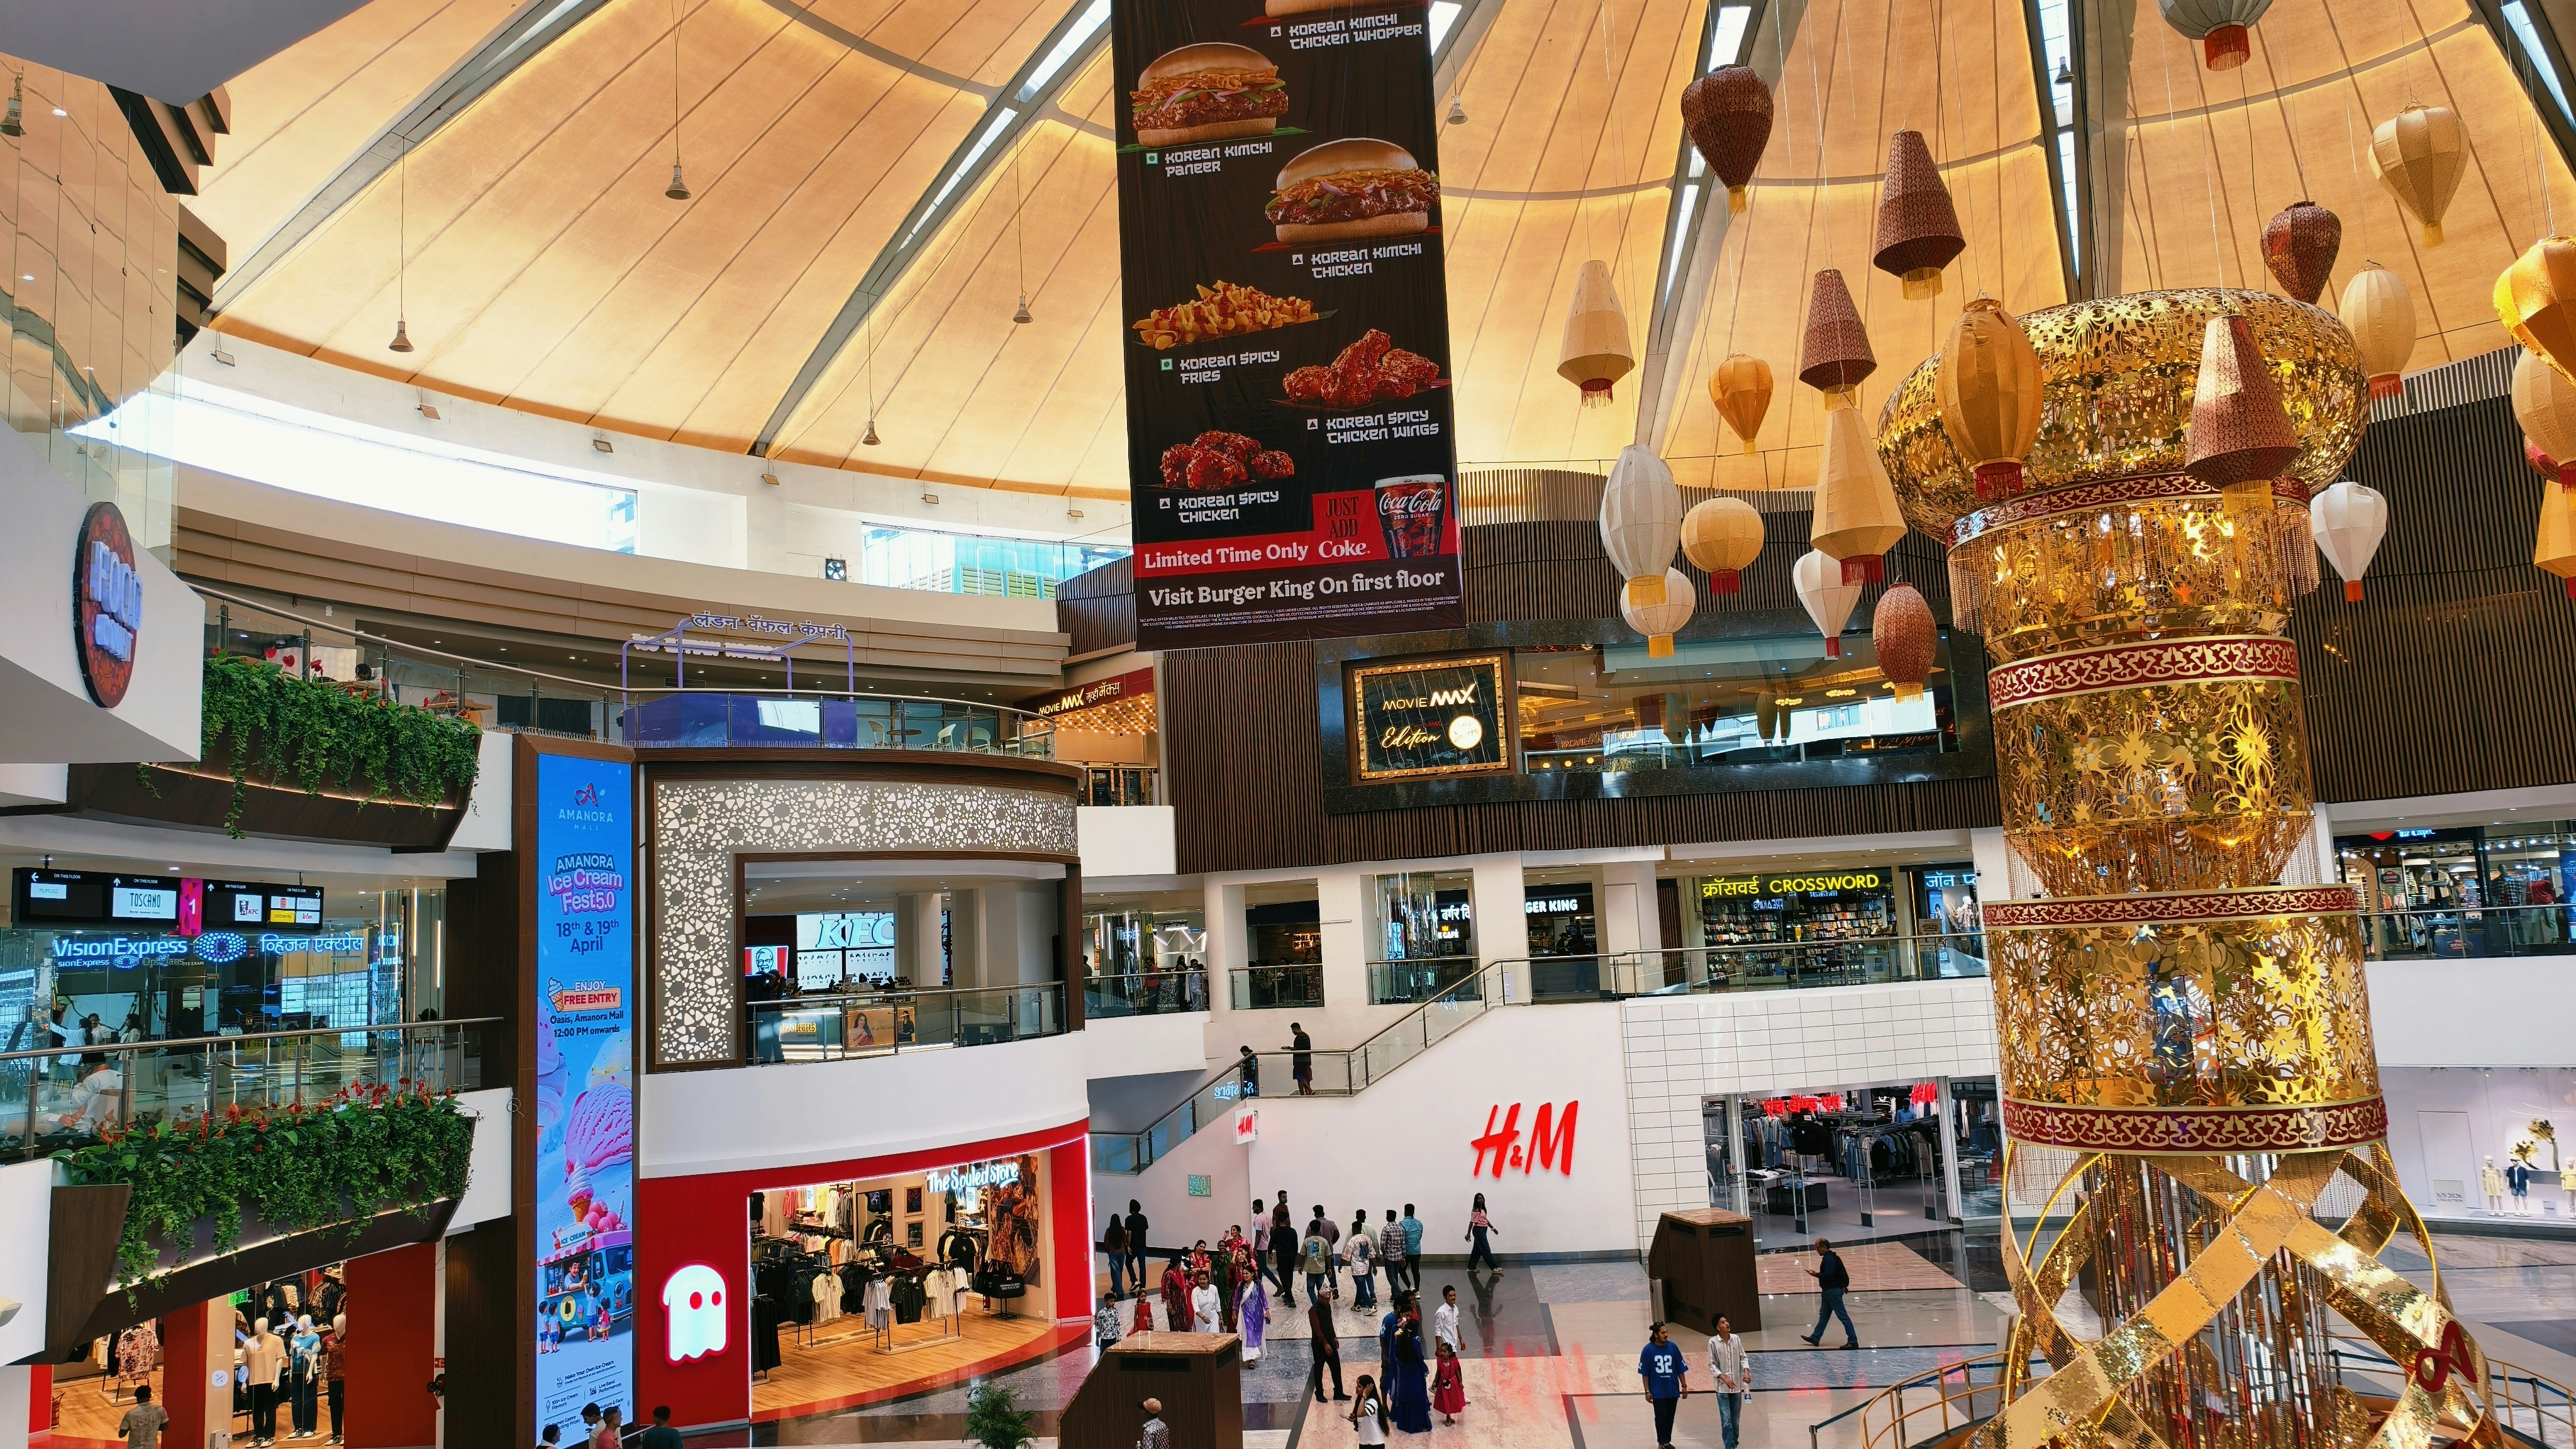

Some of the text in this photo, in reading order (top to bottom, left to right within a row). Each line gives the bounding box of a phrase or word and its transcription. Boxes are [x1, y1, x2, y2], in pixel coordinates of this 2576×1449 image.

[1350, 14, 1397, 31] KIMCHI
[1354, 24, 1422, 43] WHOPPER
[1224, 142, 1272, 157] KIMCHI
[1372, 243, 1421, 260] KIMCHI
[1240, 350, 1280, 365] SPICY
[1388, 409, 1430, 425] SPICY
[1240, 491, 1279, 504] SPICY
[1325, 497, 1358, 517] JUST
[1329, 518, 1358, 538] ADD
[1144, 542, 1309, 569] Limited Time Only
[90, 541, 143, 631] FOOD
[1149, 569, 1445, 606] Visit Burger King On first floor
[799, 620, 847, 640] कंपनी
[1038, 702, 1060, 714] MOVIE
[1382, 698, 1427, 711] MOVIE
[1382, 726, 1441, 750] Edition
[558, 808, 614, 823] AMANORA
[557, 855, 614, 872] AMANORA
[549, 869, 623, 892] Ice Cream
[1770, 874, 1879, 893] CROSSWORD
[130, 892, 161, 908] TOSCANO
[189, 899, 196, 914] 1
[1549, 899, 1578, 911] KING
[556, 919, 619, 938] 18th & 19th
[816, 917, 894, 948] KFC
[570, 936, 603, 955] April
[574, 980, 606, 992] ENJOY
[564, 992, 618, 1005] FREE ENTRY
[550, 1011, 624, 1024] Oasis, Amanora Mall
[554, 1024, 620, 1038] 12:00 PM onwards
[1470, 1100, 1579, 1179] H&M
[927, 1172, 950, 1193] The
[951, 1165, 989, 1189] Souled
[570, 1231, 586, 1241] CREAM
[1654, 1355, 1673, 1373] 32
[599, 1382, 621, 1394] Performances
[552, 1402, 567, 1411] Flavours
